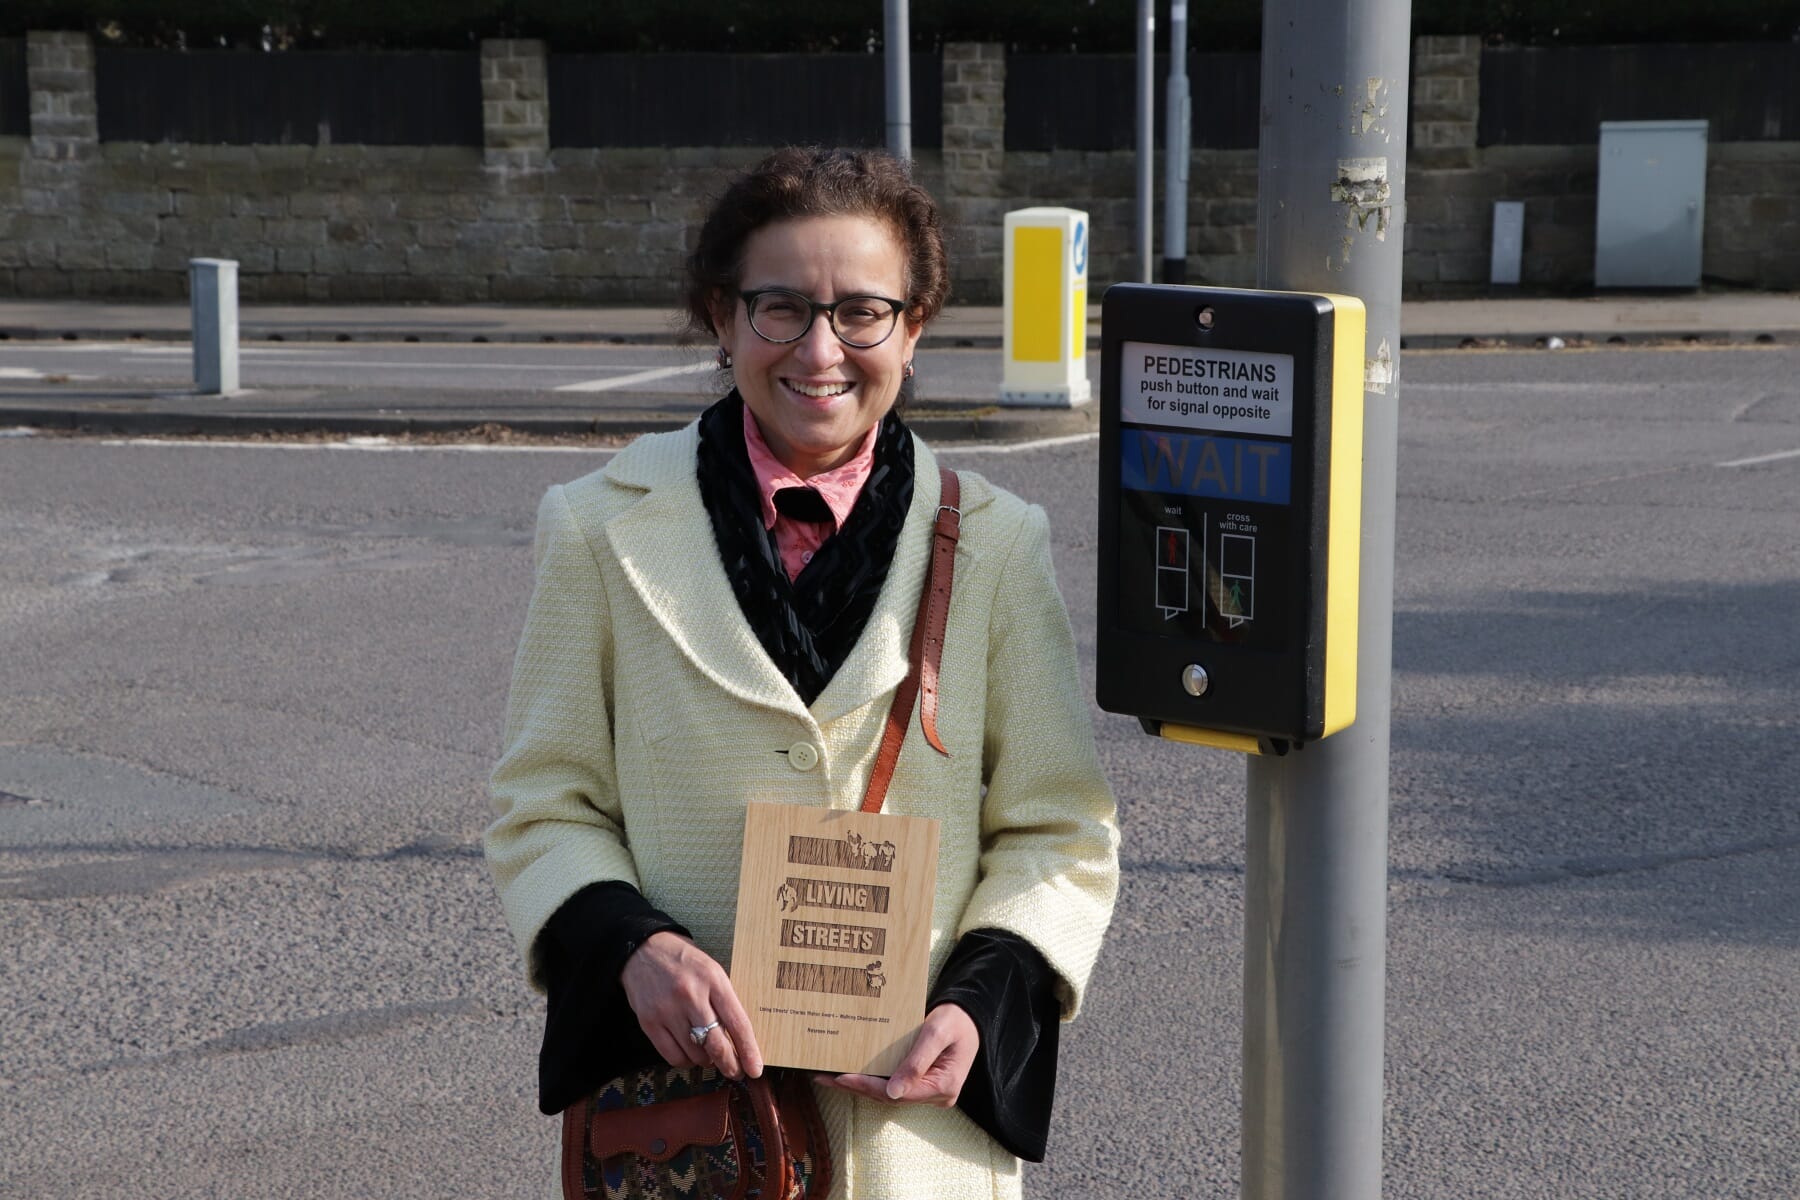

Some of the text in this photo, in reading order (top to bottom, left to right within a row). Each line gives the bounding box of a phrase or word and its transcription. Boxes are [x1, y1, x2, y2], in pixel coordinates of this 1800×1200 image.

[1144, 355, 1276, 383] PEDESTRIANS
[1140, 379, 1279, 401] push button and wait
[1147, 396, 1271, 420] for signal opposite
[1139, 434, 1281, 497] WAIT
[1164, 505, 1182, 515] wait
[1226, 513, 1250, 522] cross
[1219, 521, 1257, 533] with care
[806, 883, 867, 908] LIVING
[792, 924, 873, 951] STREETS
